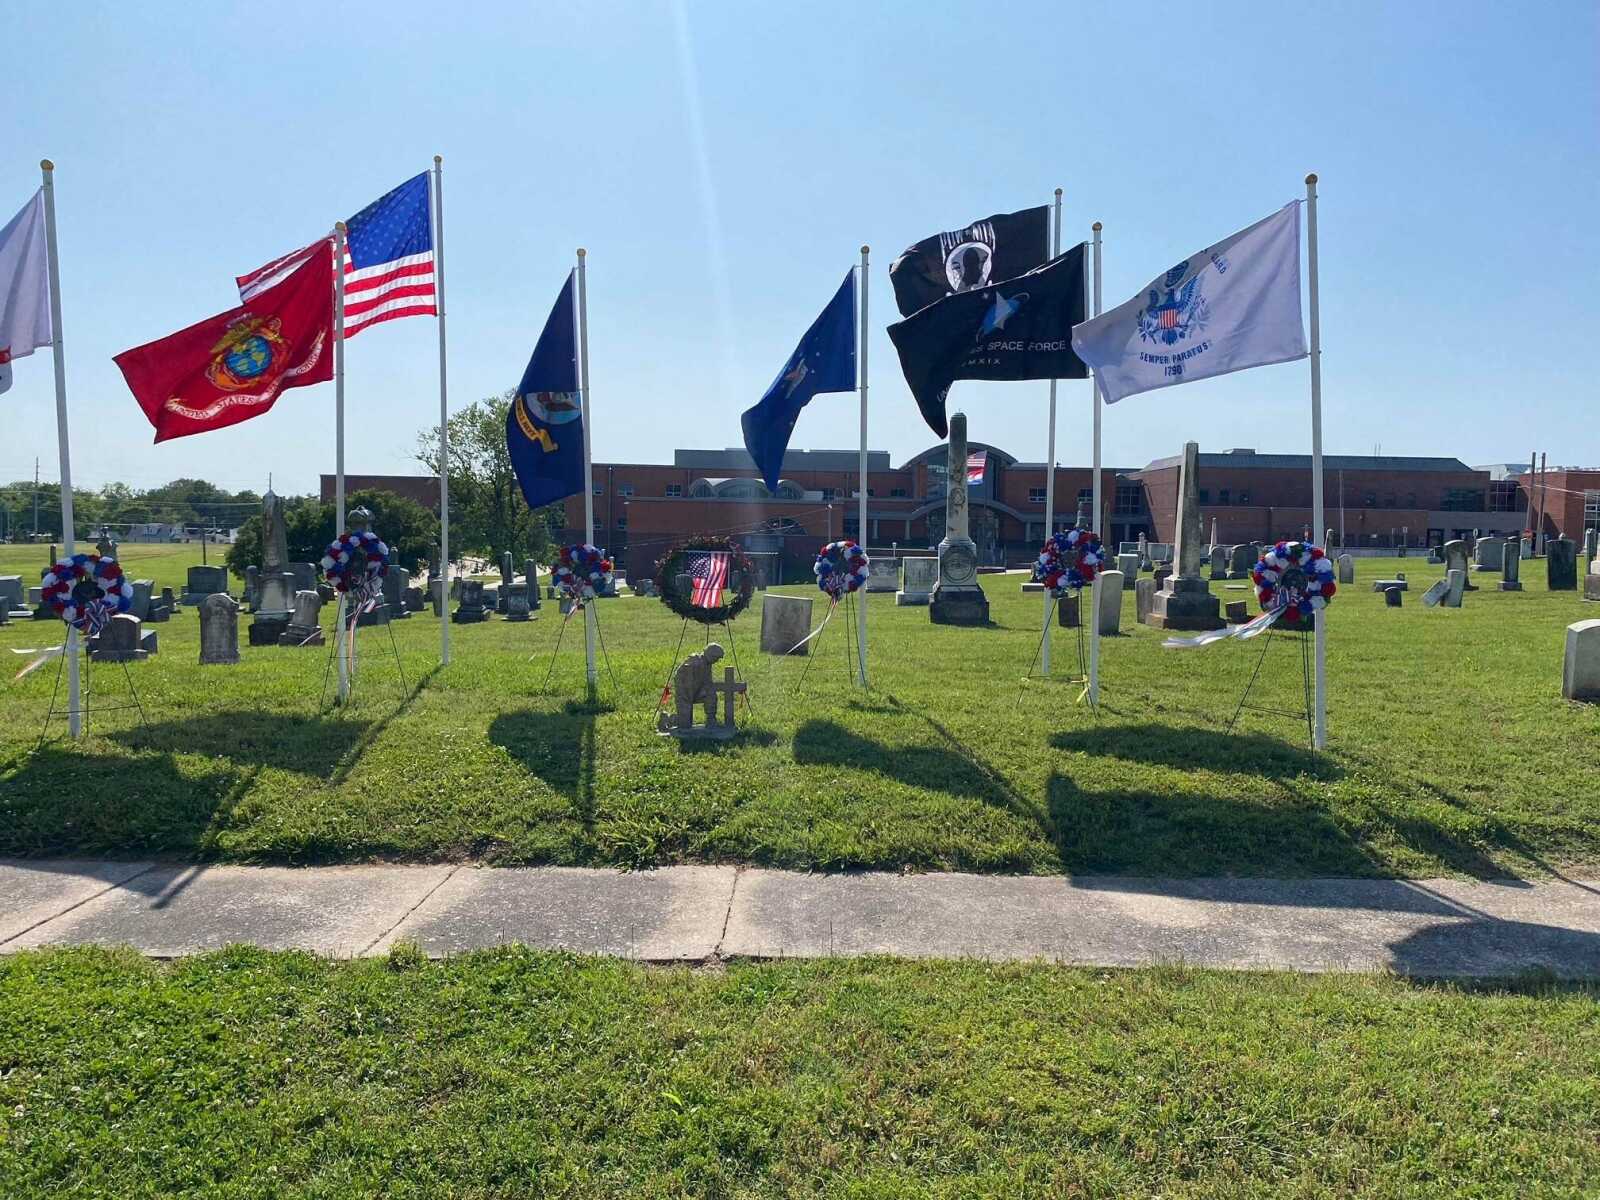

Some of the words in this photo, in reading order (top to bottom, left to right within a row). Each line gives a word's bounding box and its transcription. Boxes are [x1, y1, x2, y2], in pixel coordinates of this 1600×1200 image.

[987, 341, 1025, 351] SPACE
[1028, 340, 1067, 352] FORCE
[1139, 351, 1169, 364] SEMPER
[1172, 341, 1209, 364] PARATUS
[1164, 364, 1183, 377] 1790
